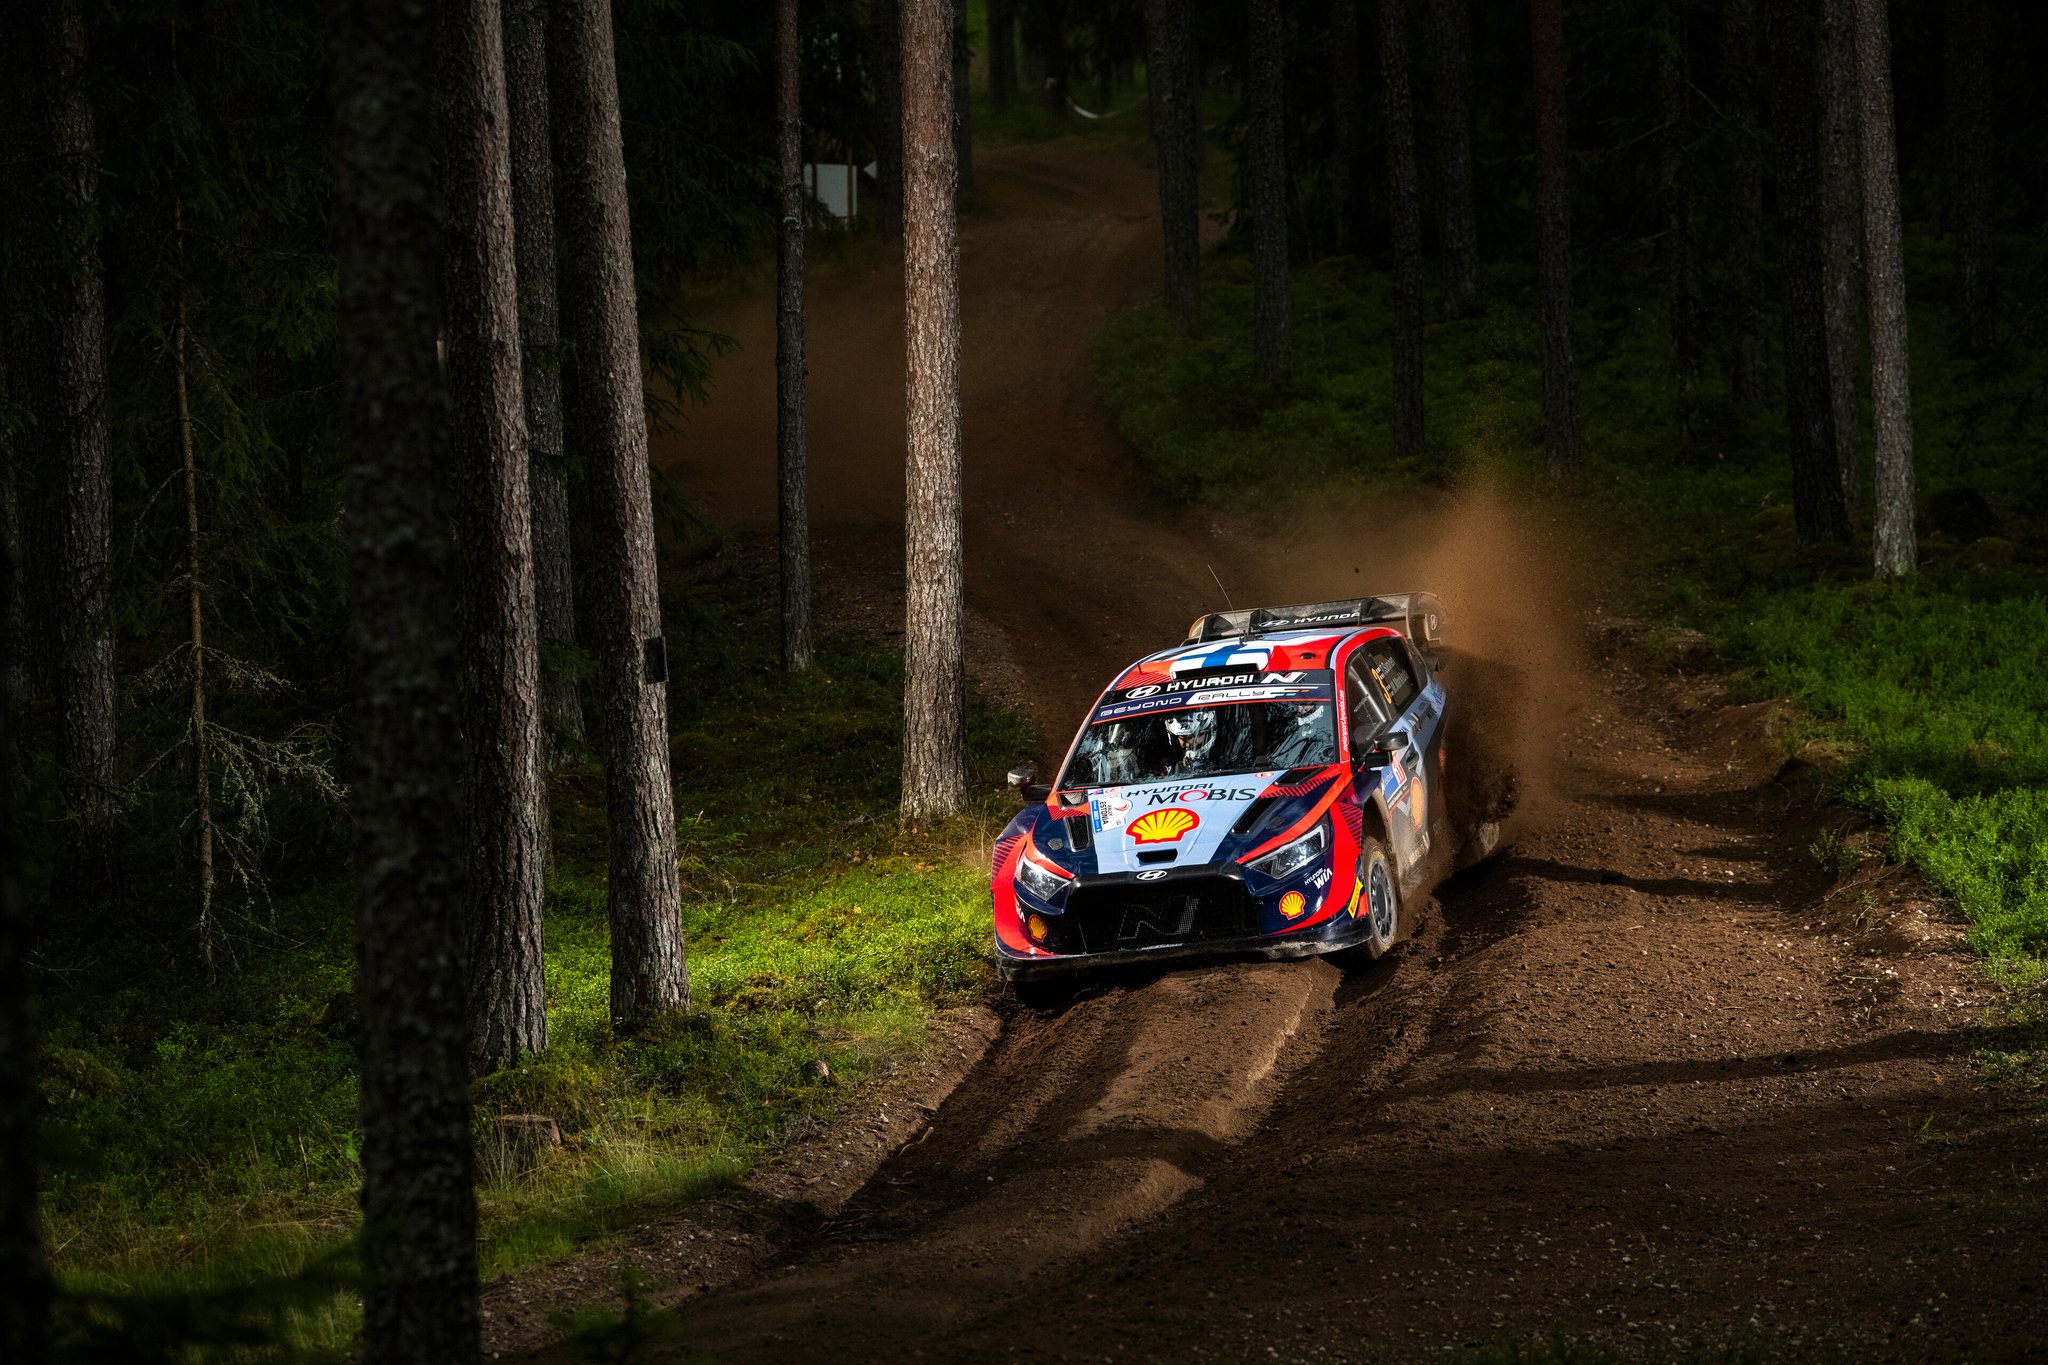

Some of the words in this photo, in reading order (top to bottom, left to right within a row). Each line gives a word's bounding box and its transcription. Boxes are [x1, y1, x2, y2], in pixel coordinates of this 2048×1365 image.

[1293, 612, 1361, 624] HYUNDA
[1166, 674, 1254, 692] HYUNDAI
[1100, 697, 1182, 718] BEYOND
[1198, 690, 1266, 701] RALLY
[1126, 783, 1214, 798] HYUNDAI
[1147, 788, 1256, 806] MOBIS
[1099, 801, 1109, 826] ESTONIA
[1313, 867, 1334, 890] WIA
